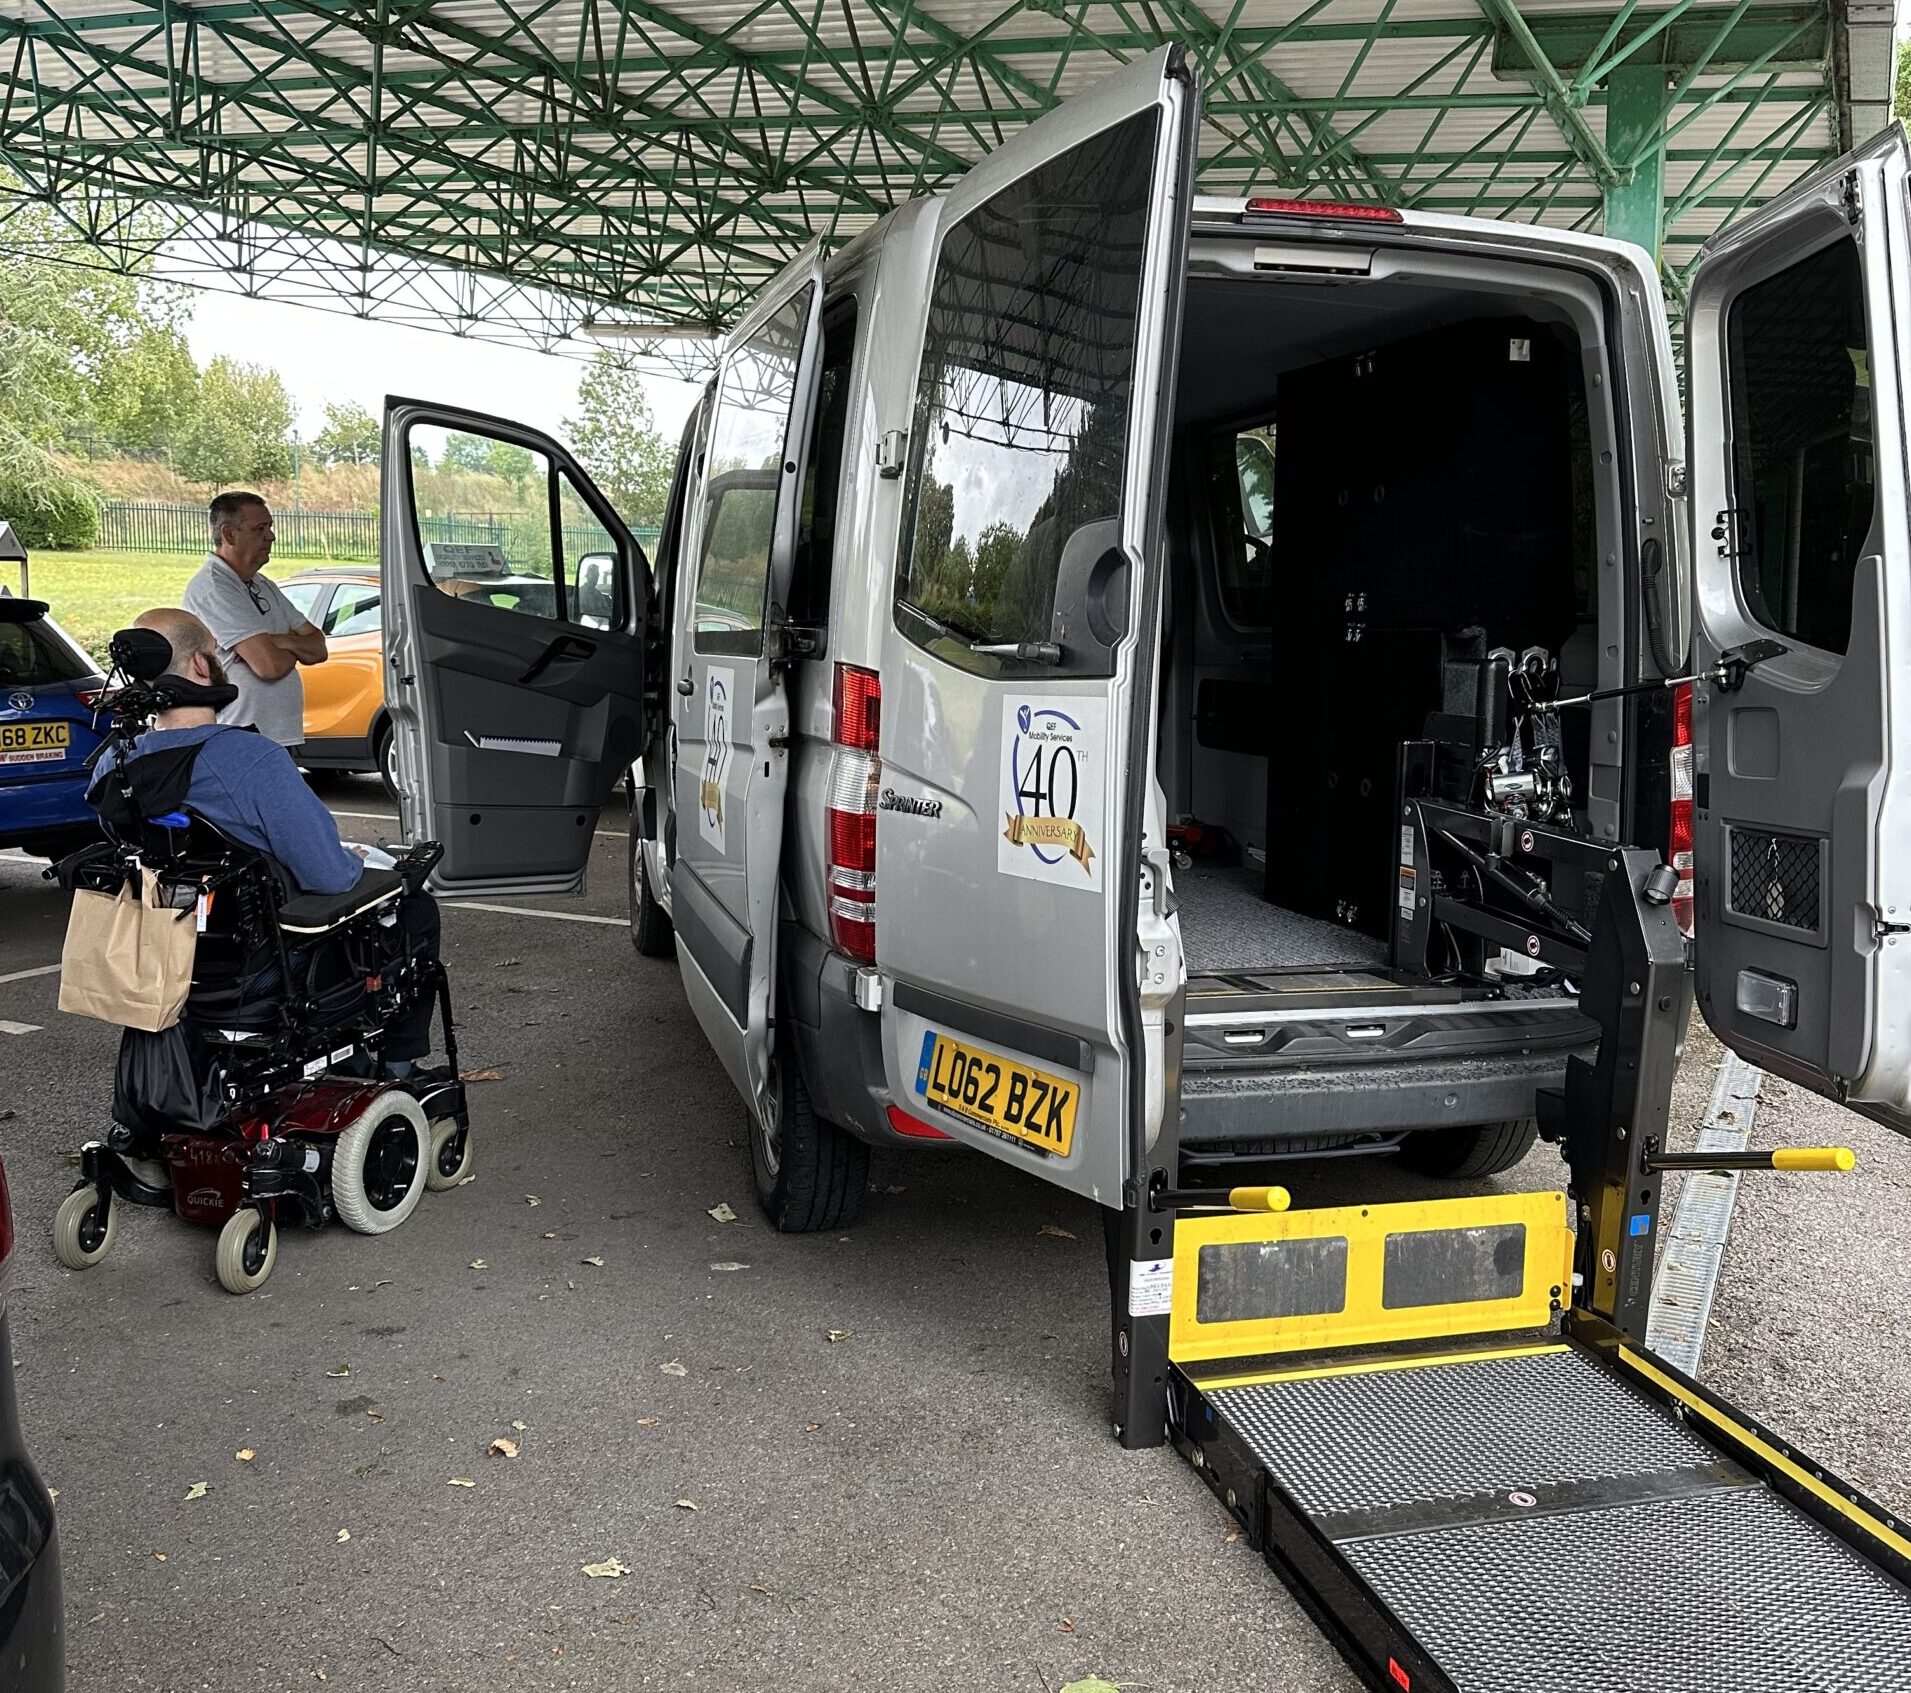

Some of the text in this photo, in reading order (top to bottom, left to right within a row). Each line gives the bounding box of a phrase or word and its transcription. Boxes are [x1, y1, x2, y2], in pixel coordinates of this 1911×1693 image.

[443, 545, 472, 554] QEF
[1046, 721, 1057, 731] QEF
[0, 725, 66, 747] 68 ZKC
[1028, 731, 1073, 743] Mobility Services
[9, 753, 35, 762] SUDDEN
[36, 751, 63, 760] BRAKING
[1018, 743, 1089, 820] 40 TH
[1020, 825, 1078, 843] ANNIVERSARY
[1003, 1071, 1071, 1144] BZK
[187, 1195, 225, 1208] QUICKIE
